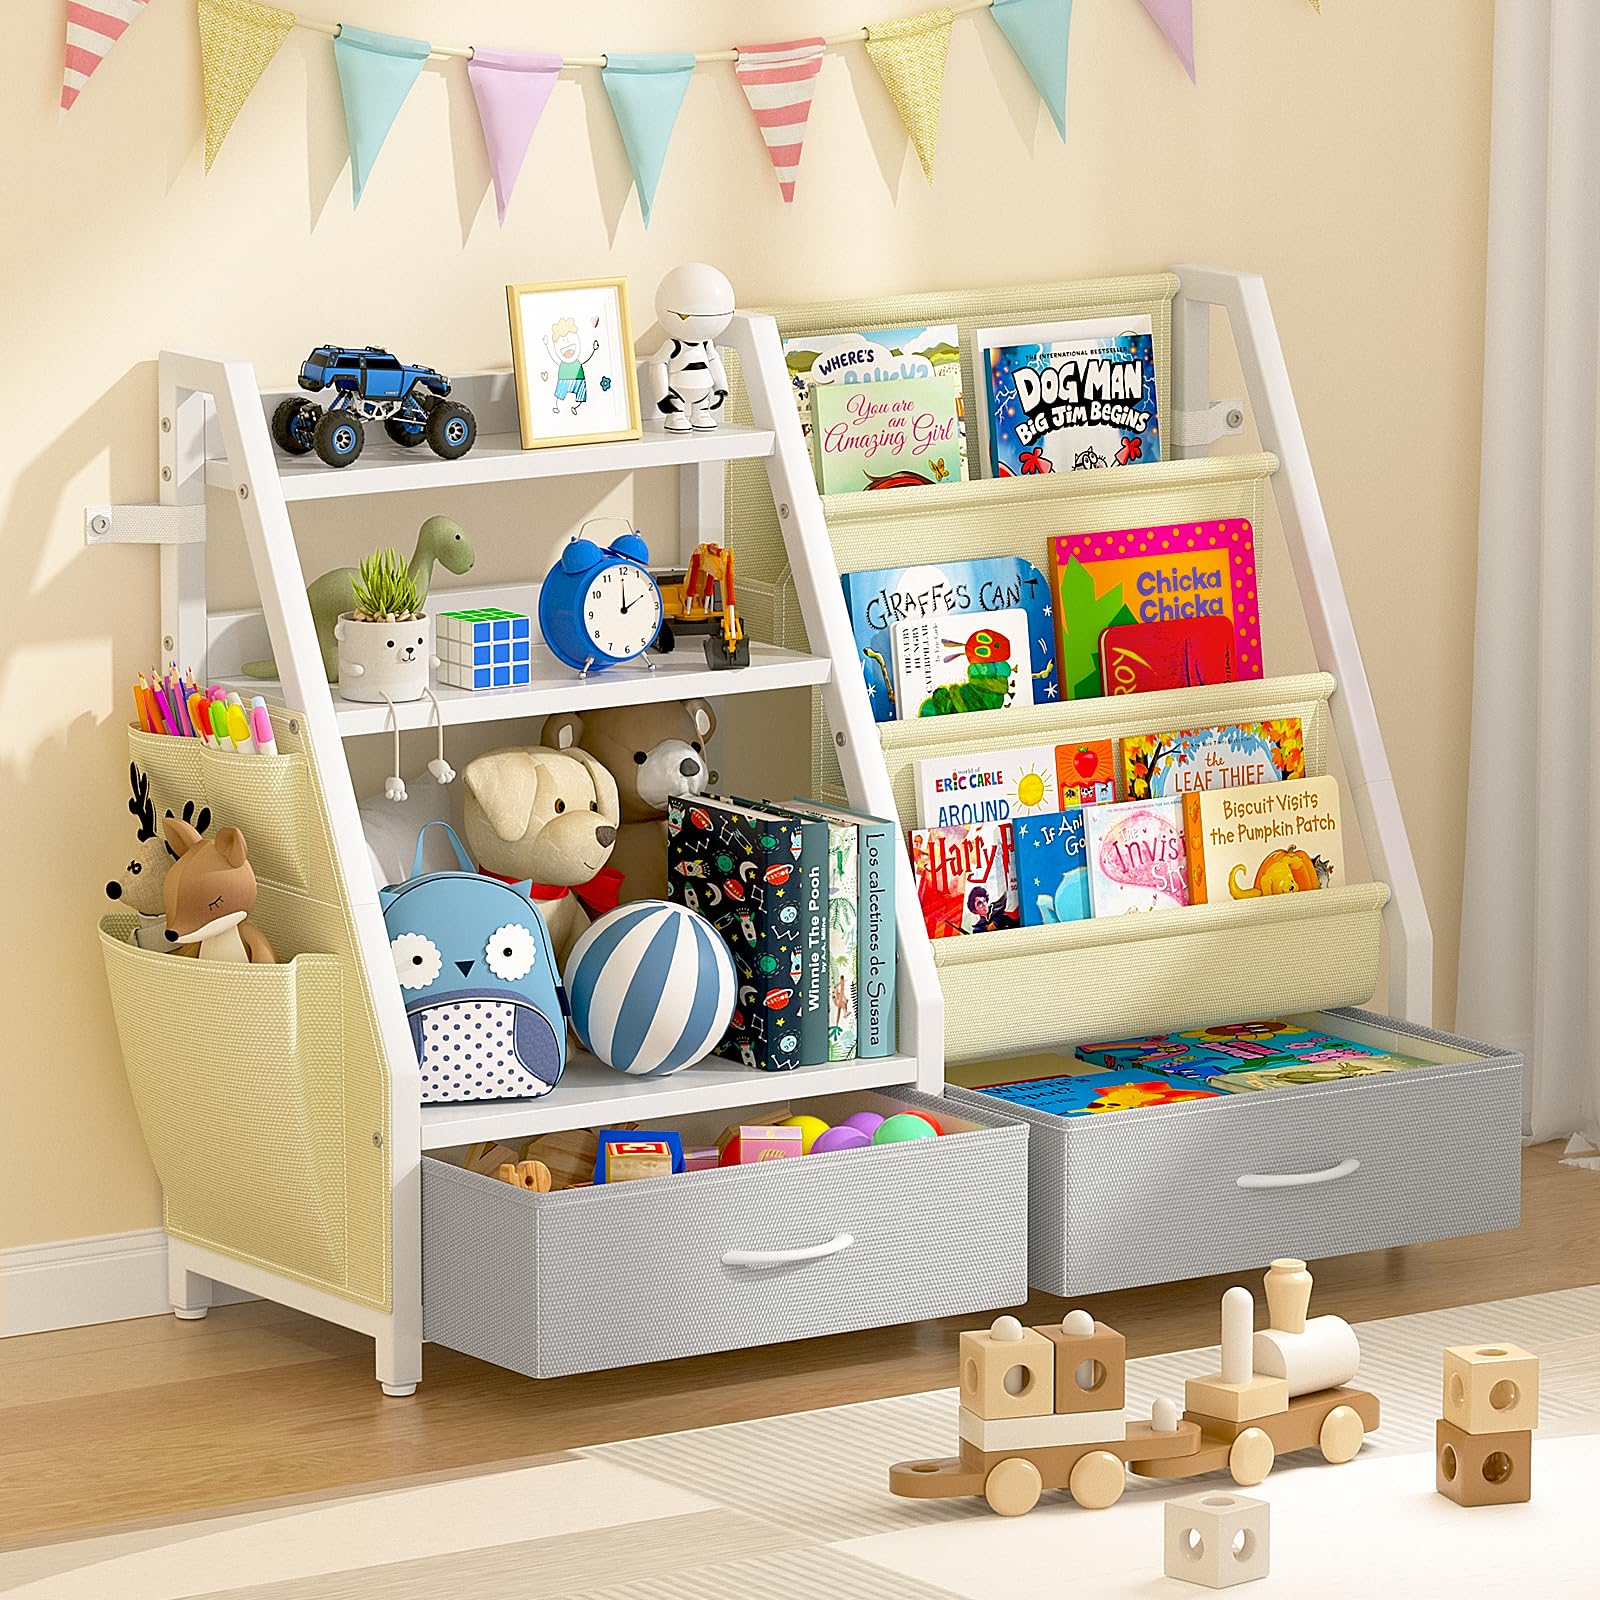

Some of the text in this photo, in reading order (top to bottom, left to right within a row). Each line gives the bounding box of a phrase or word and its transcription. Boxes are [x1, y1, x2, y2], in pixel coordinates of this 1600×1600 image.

[1039, 350, 1088, 360] INTERNATIONAL
[1090, 346, 1127, 356] BESTSELLER
[819, 349, 875, 377] WHERE'S
[1012, 359, 1142, 413] DOG MAN
[846, 394, 914, 426] You are
[888, 417, 907, 428] an
[824, 413, 954, 458] Amazing Girl
[603, 574, 611, 583] 11
[619, 566, 628, 576] 12
[636, 570, 640, 579] 1
[648, 582, 654, 592] 2
[1136, 567, 1222, 596] Chicka
[592, 590, 602, 599] 10
[865, 575, 1039, 630] GIRAFFES CAN'T
[654, 601, 660, 610] 3
[1139, 594, 1223, 623] Chicka
[588, 611, 594, 619] 9
[651, 621, 657, 629] 4
[594, 630, 600, 639] 8
[641, 637, 646, 647] 5
[607, 642, 613, 651] 7
[624, 645, 631, 654] 6
[1204, 751, 1226, 768] the
[969, 771, 1003, 789] CARLE
[1175, 764, 1265, 792] LEAF THIEF
[938, 799, 1010, 827] AROUND
[1223, 790, 1318, 820] Biscuit Visits
[1041, 826, 1055, 845] If
[1210, 813, 1336, 845] the Pumpkin Patch
[924, 833, 998, 896] Harry
[808, 865, 820, 1012] Winnie The Pooh
[866, 833, 886, 1046] Los calcetines de Susana
[821, 961, 827, 973] by
